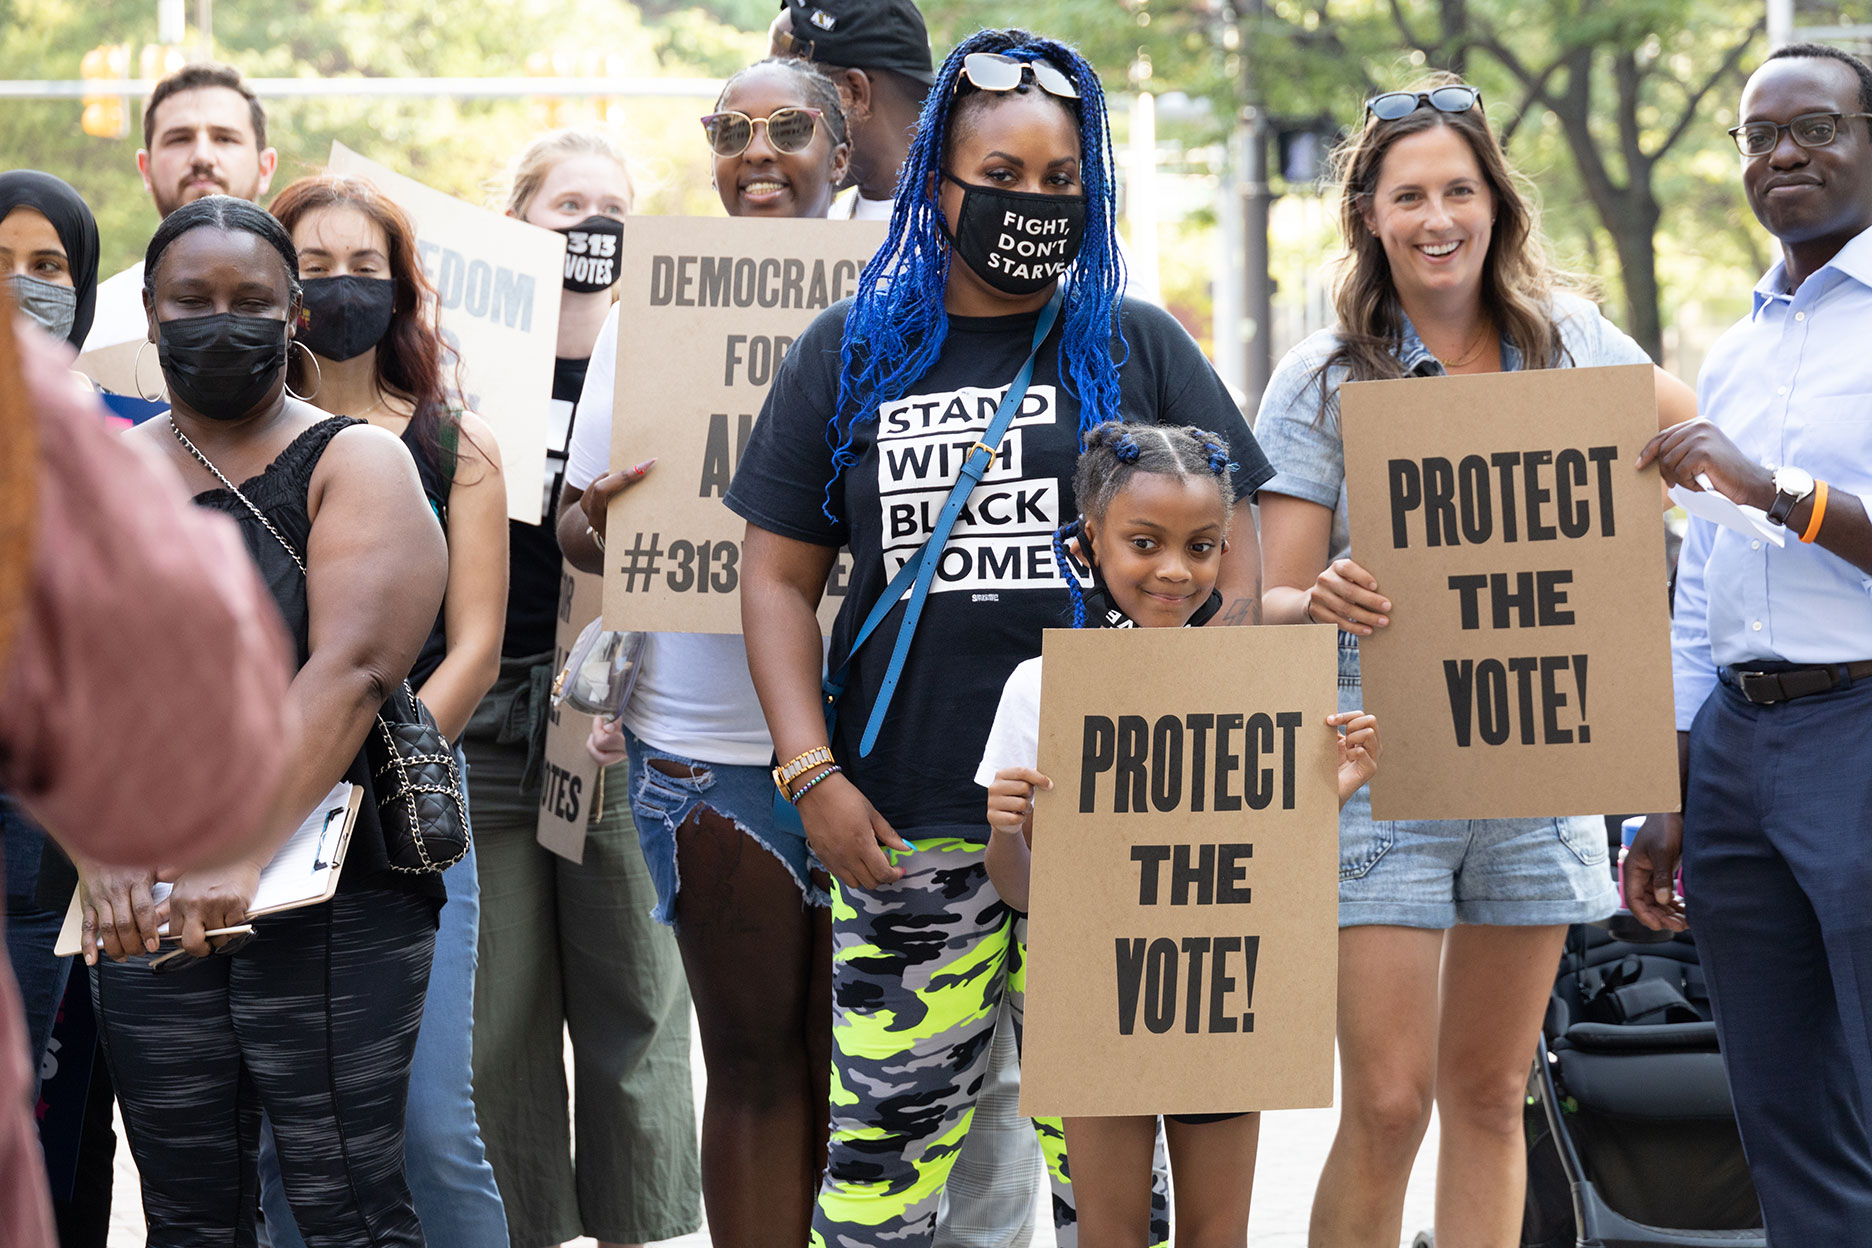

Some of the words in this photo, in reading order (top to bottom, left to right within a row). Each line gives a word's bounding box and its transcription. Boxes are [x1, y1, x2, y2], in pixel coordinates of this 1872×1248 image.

[567, 231, 617, 258] 313
[998, 233, 1068, 258] DON'T
[1003, 210, 1070, 236] FIGHT,
[564, 253, 614, 285] VOTES
[650, 254, 868, 310] DEMOCRAC
[1388, 446, 1618, 549] PROTECT
[1448, 569, 1576, 630] THE
[1443, 654, 1591, 747] VOTE!
[1079, 711, 1303, 813] PROTECT
[1130, 843, 1254, 906] THE
[1115, 936, 1261, 1036] VOTE!
